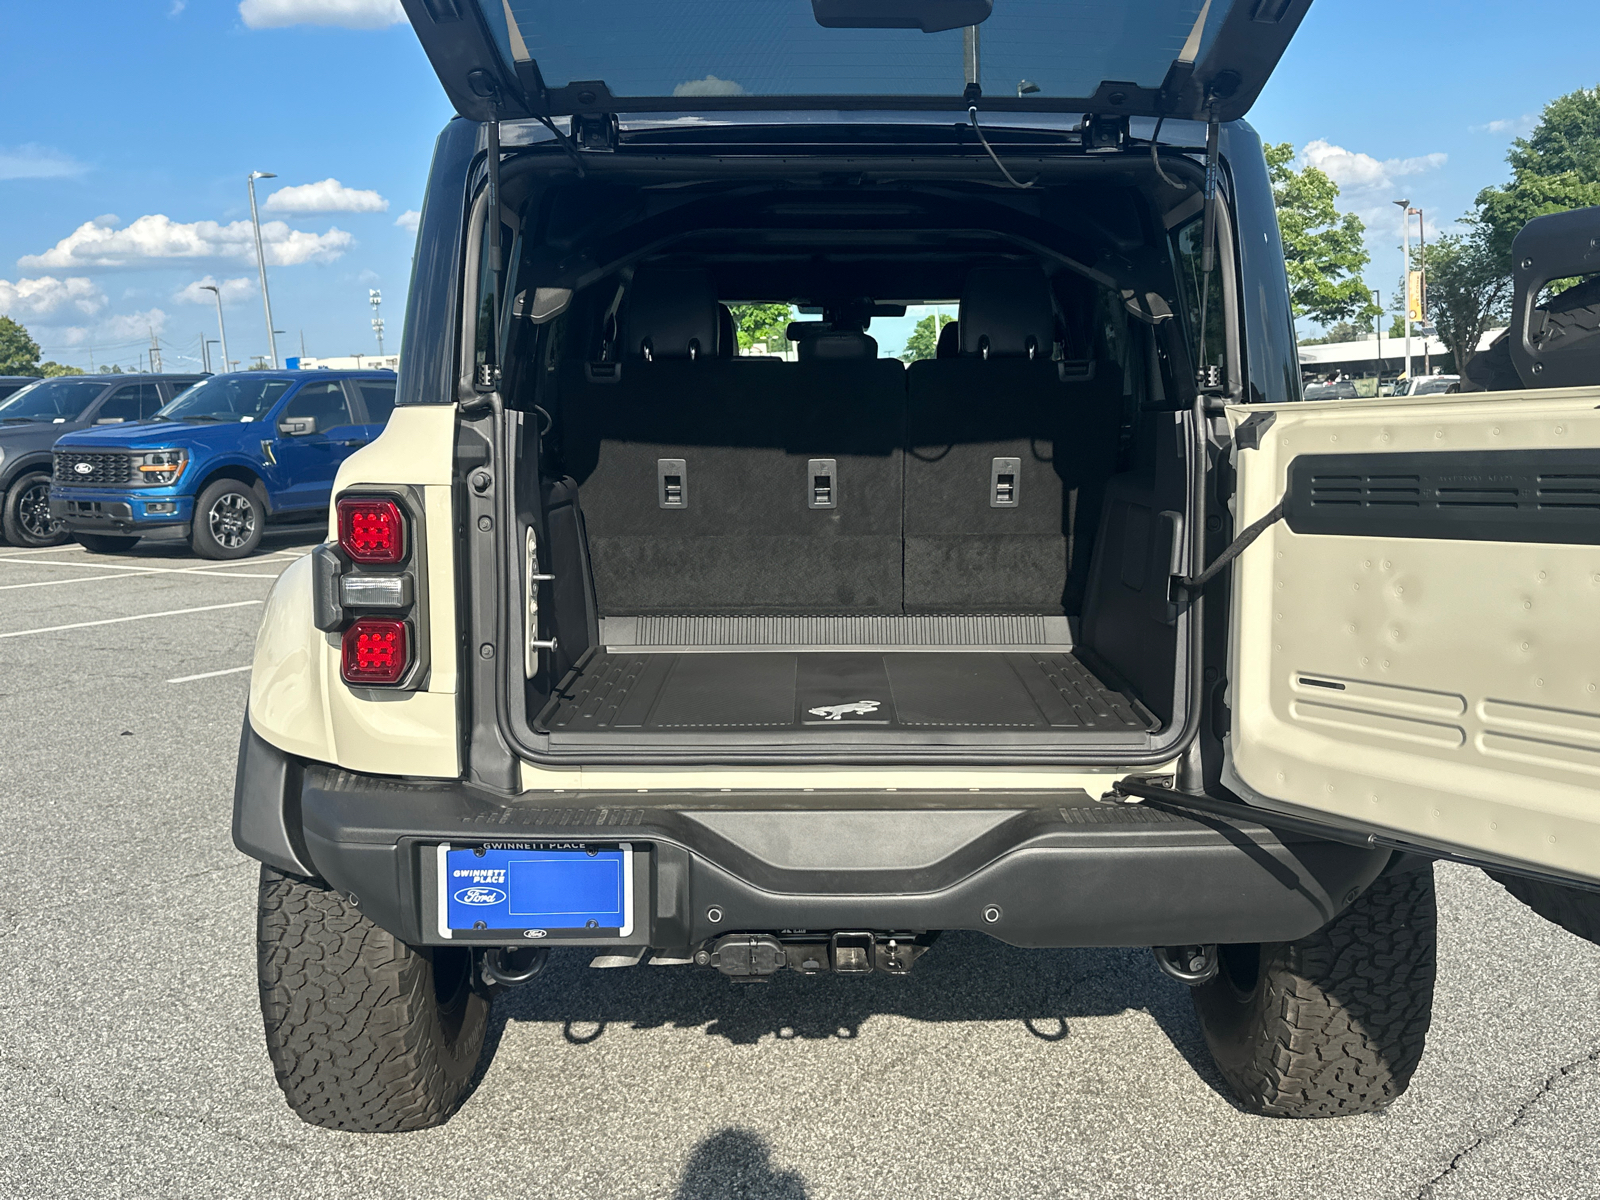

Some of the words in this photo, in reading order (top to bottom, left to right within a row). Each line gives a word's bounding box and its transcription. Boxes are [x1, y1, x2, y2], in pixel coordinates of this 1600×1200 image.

[453, 869, 506, 878] GWINNETT
[473, 876, 505, 884] PLACE
[463, 889, 497, 904] Ford
